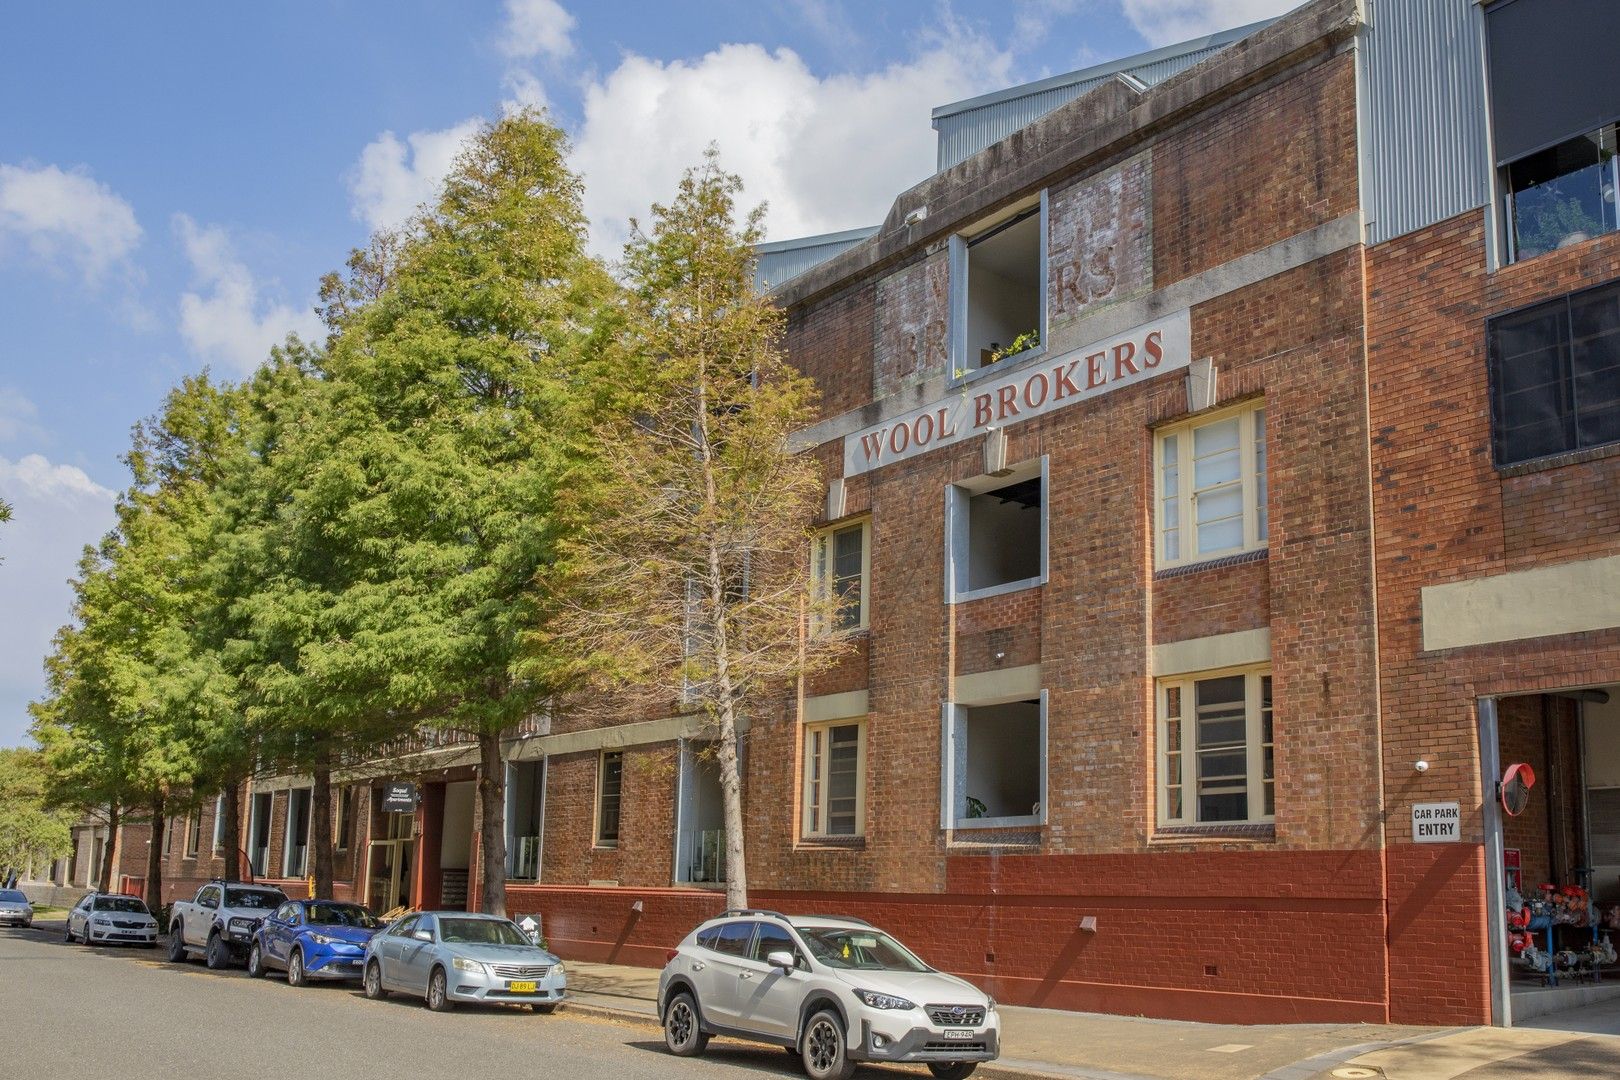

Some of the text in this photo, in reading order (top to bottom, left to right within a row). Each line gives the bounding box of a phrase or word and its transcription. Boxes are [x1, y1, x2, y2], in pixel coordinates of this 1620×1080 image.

[860, 329, 1165, 464] WOOL BROKERS
[1414, 808, 1458, 819] CAR PARK
[1418, 823, 1455, 836] ENTRY
